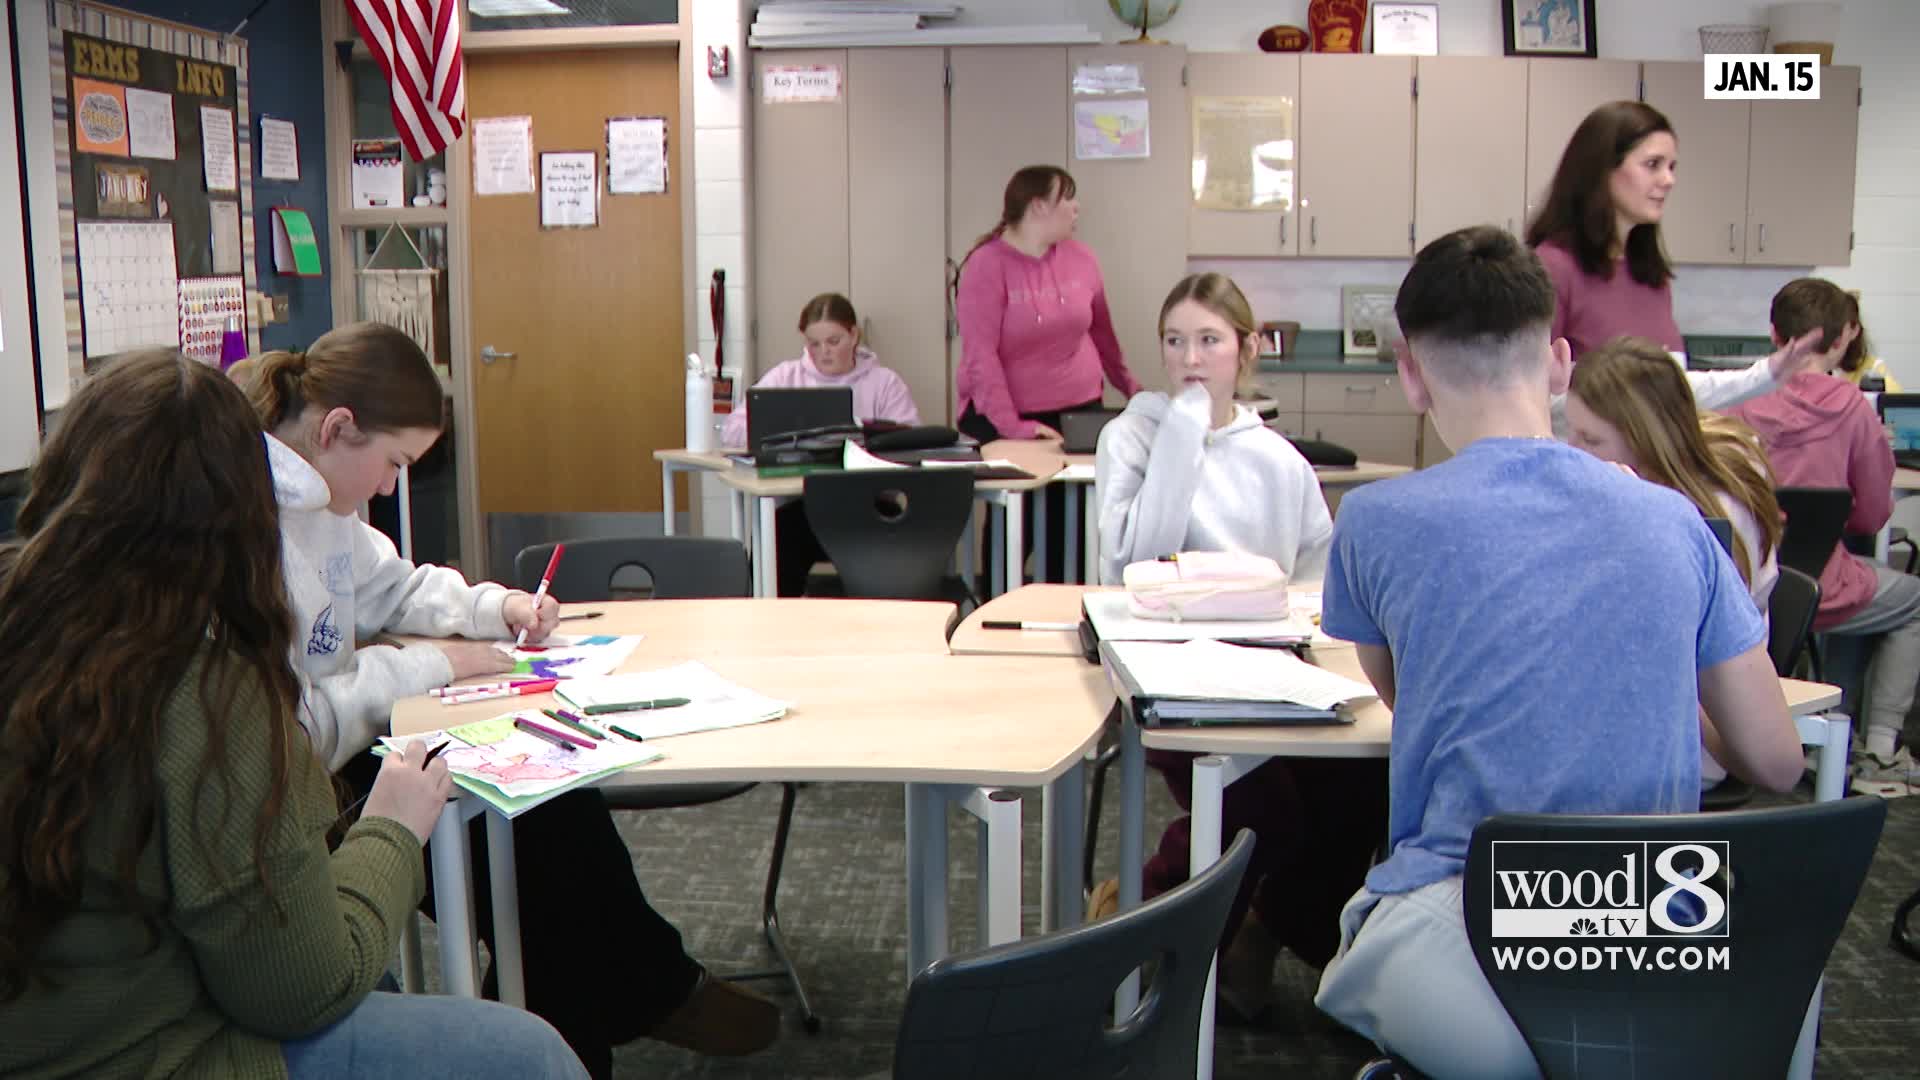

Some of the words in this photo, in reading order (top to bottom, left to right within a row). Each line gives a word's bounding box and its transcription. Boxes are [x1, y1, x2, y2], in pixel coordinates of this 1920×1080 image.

[73, 39, 140, 82] ERMS
[176, 59, 224, 97] INFO
[774, 77, 792, 88] Key
[798, 76, 829, 87] Terms
